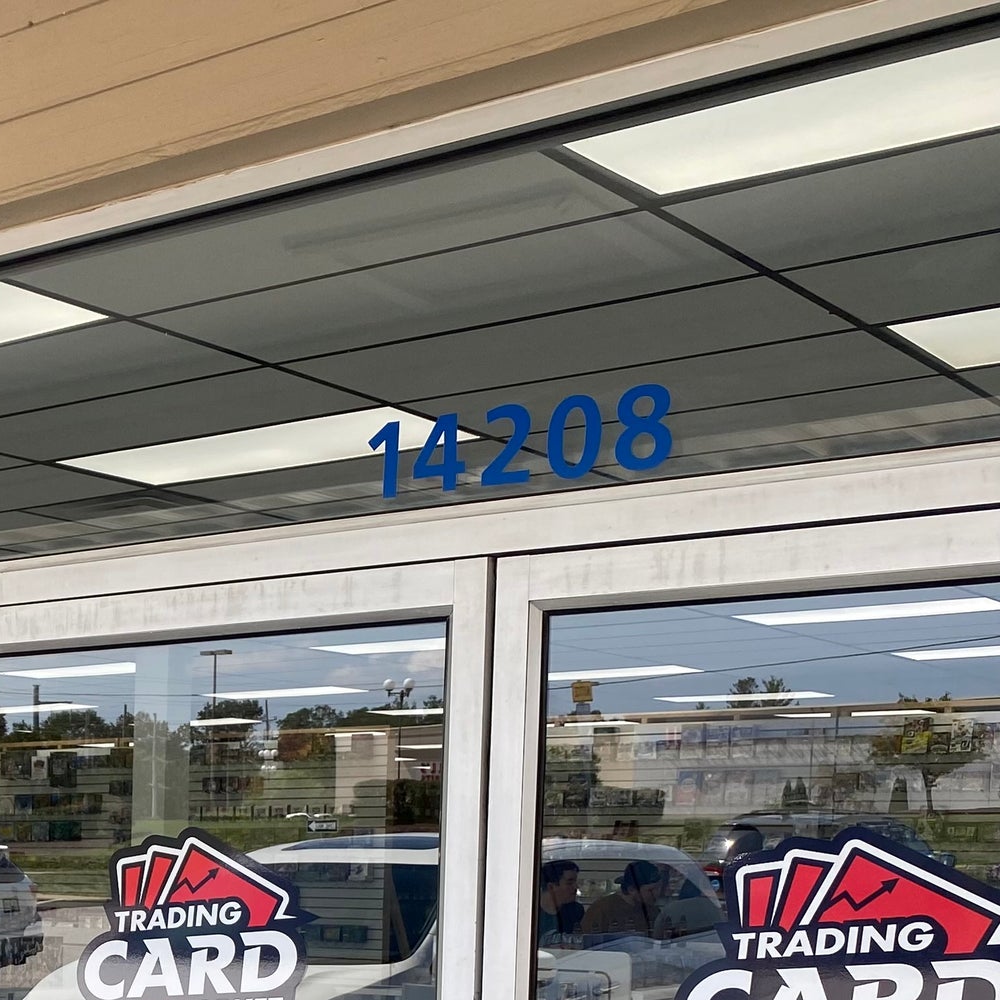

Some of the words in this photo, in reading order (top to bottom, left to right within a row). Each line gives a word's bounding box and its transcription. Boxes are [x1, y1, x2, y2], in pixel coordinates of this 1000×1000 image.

[368, 384, 673, 498] 14208
[114, 901, 242, 933] TRADING
[732, 921, 934, 960] TRADING
[84, 930, 298, 1000] CARD
